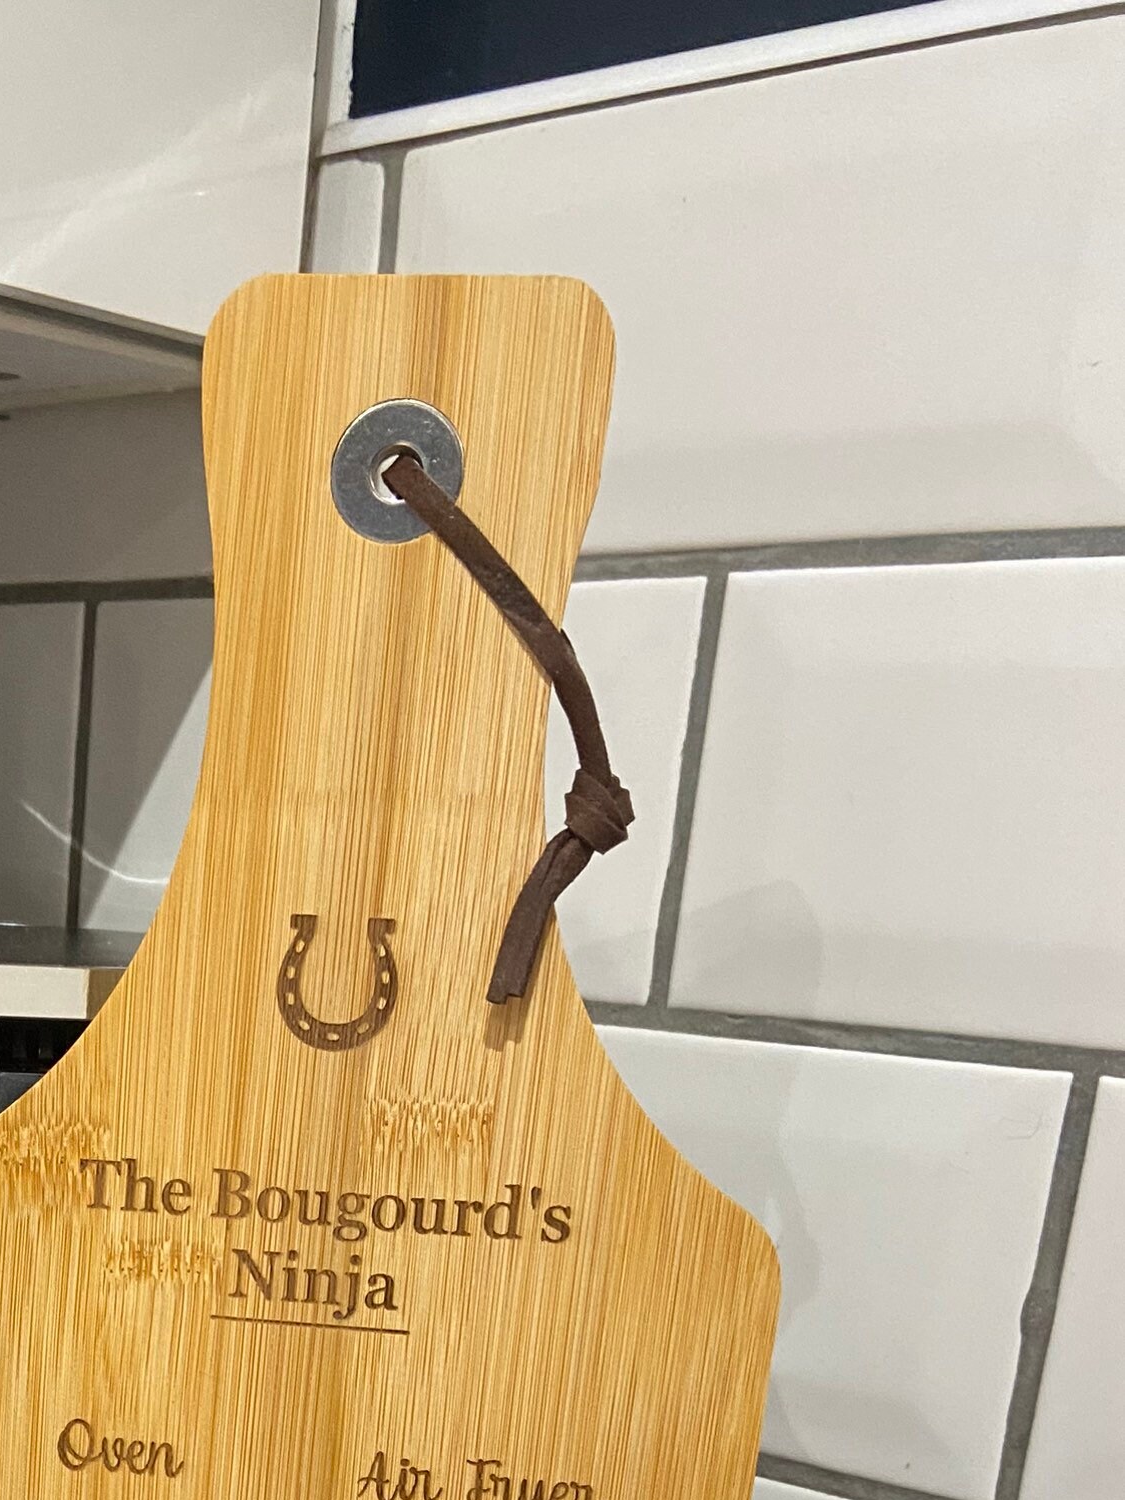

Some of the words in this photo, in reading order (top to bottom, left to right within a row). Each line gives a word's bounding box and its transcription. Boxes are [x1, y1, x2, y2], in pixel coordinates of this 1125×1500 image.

[80, 1157, 192, 1215] The
[210, 1168, 572, 1244] Bougourd's
[228, 1248, 398, 1320] Ninja
[57, 1418, 184, 1477] Oven
